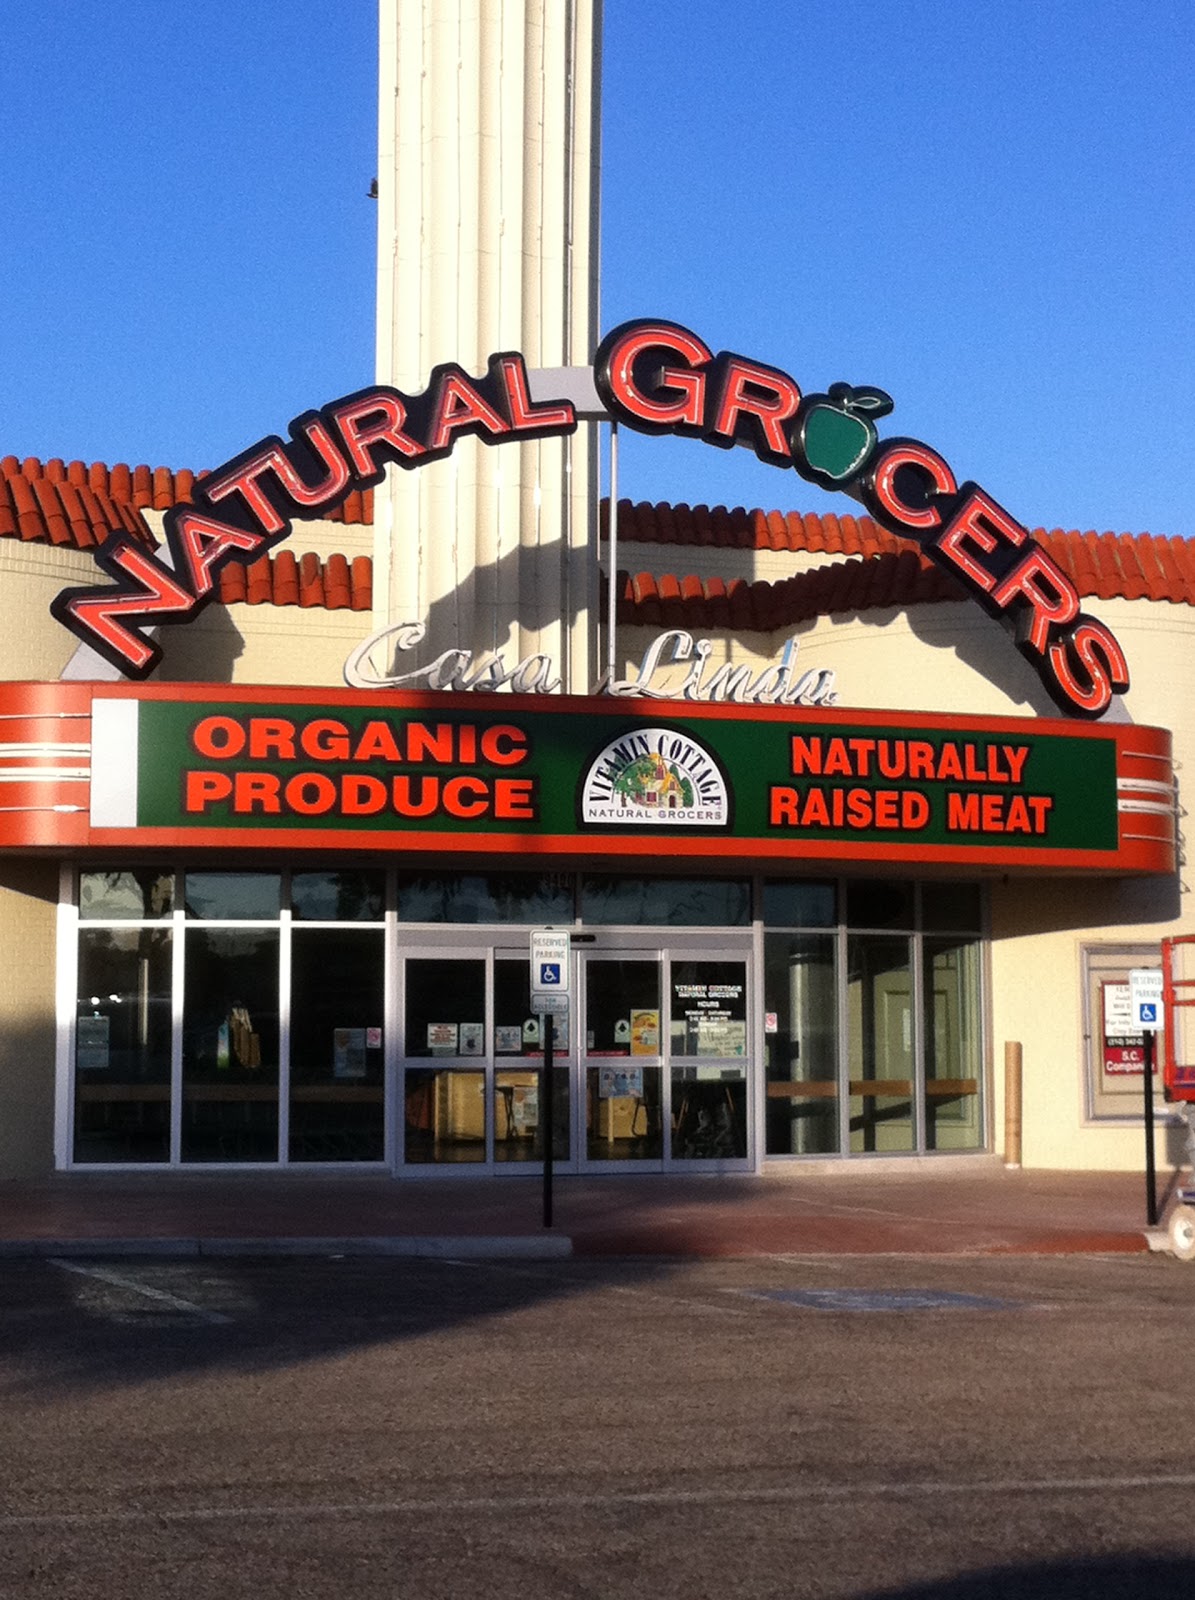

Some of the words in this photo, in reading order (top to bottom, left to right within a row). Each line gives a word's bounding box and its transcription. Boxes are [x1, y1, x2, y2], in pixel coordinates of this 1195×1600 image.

[57, 354, 576, 674] NATURAL
[343, 621, 563, 693] Casa
[606, 630, 839, 706] Linda
[193, 716, 528, 765] ORGANIC
[791, 736, 1029, 782] NATURALLY
[589, 734, 651, 801] VITAMIN
[657, 734, 722, 806] COTTAGE
[185, 771, 534, 818] PRODUCE
[588, 809, 652, 818] NATURAL
[657, 810, 722, 820] GROCERS
[770, 786, 929, 829] RAISED
[947, 793, 1052, 833] MEAT
[533, 938, 567, 947] RESERVED
[535, 951, 566, 959] PARKING
